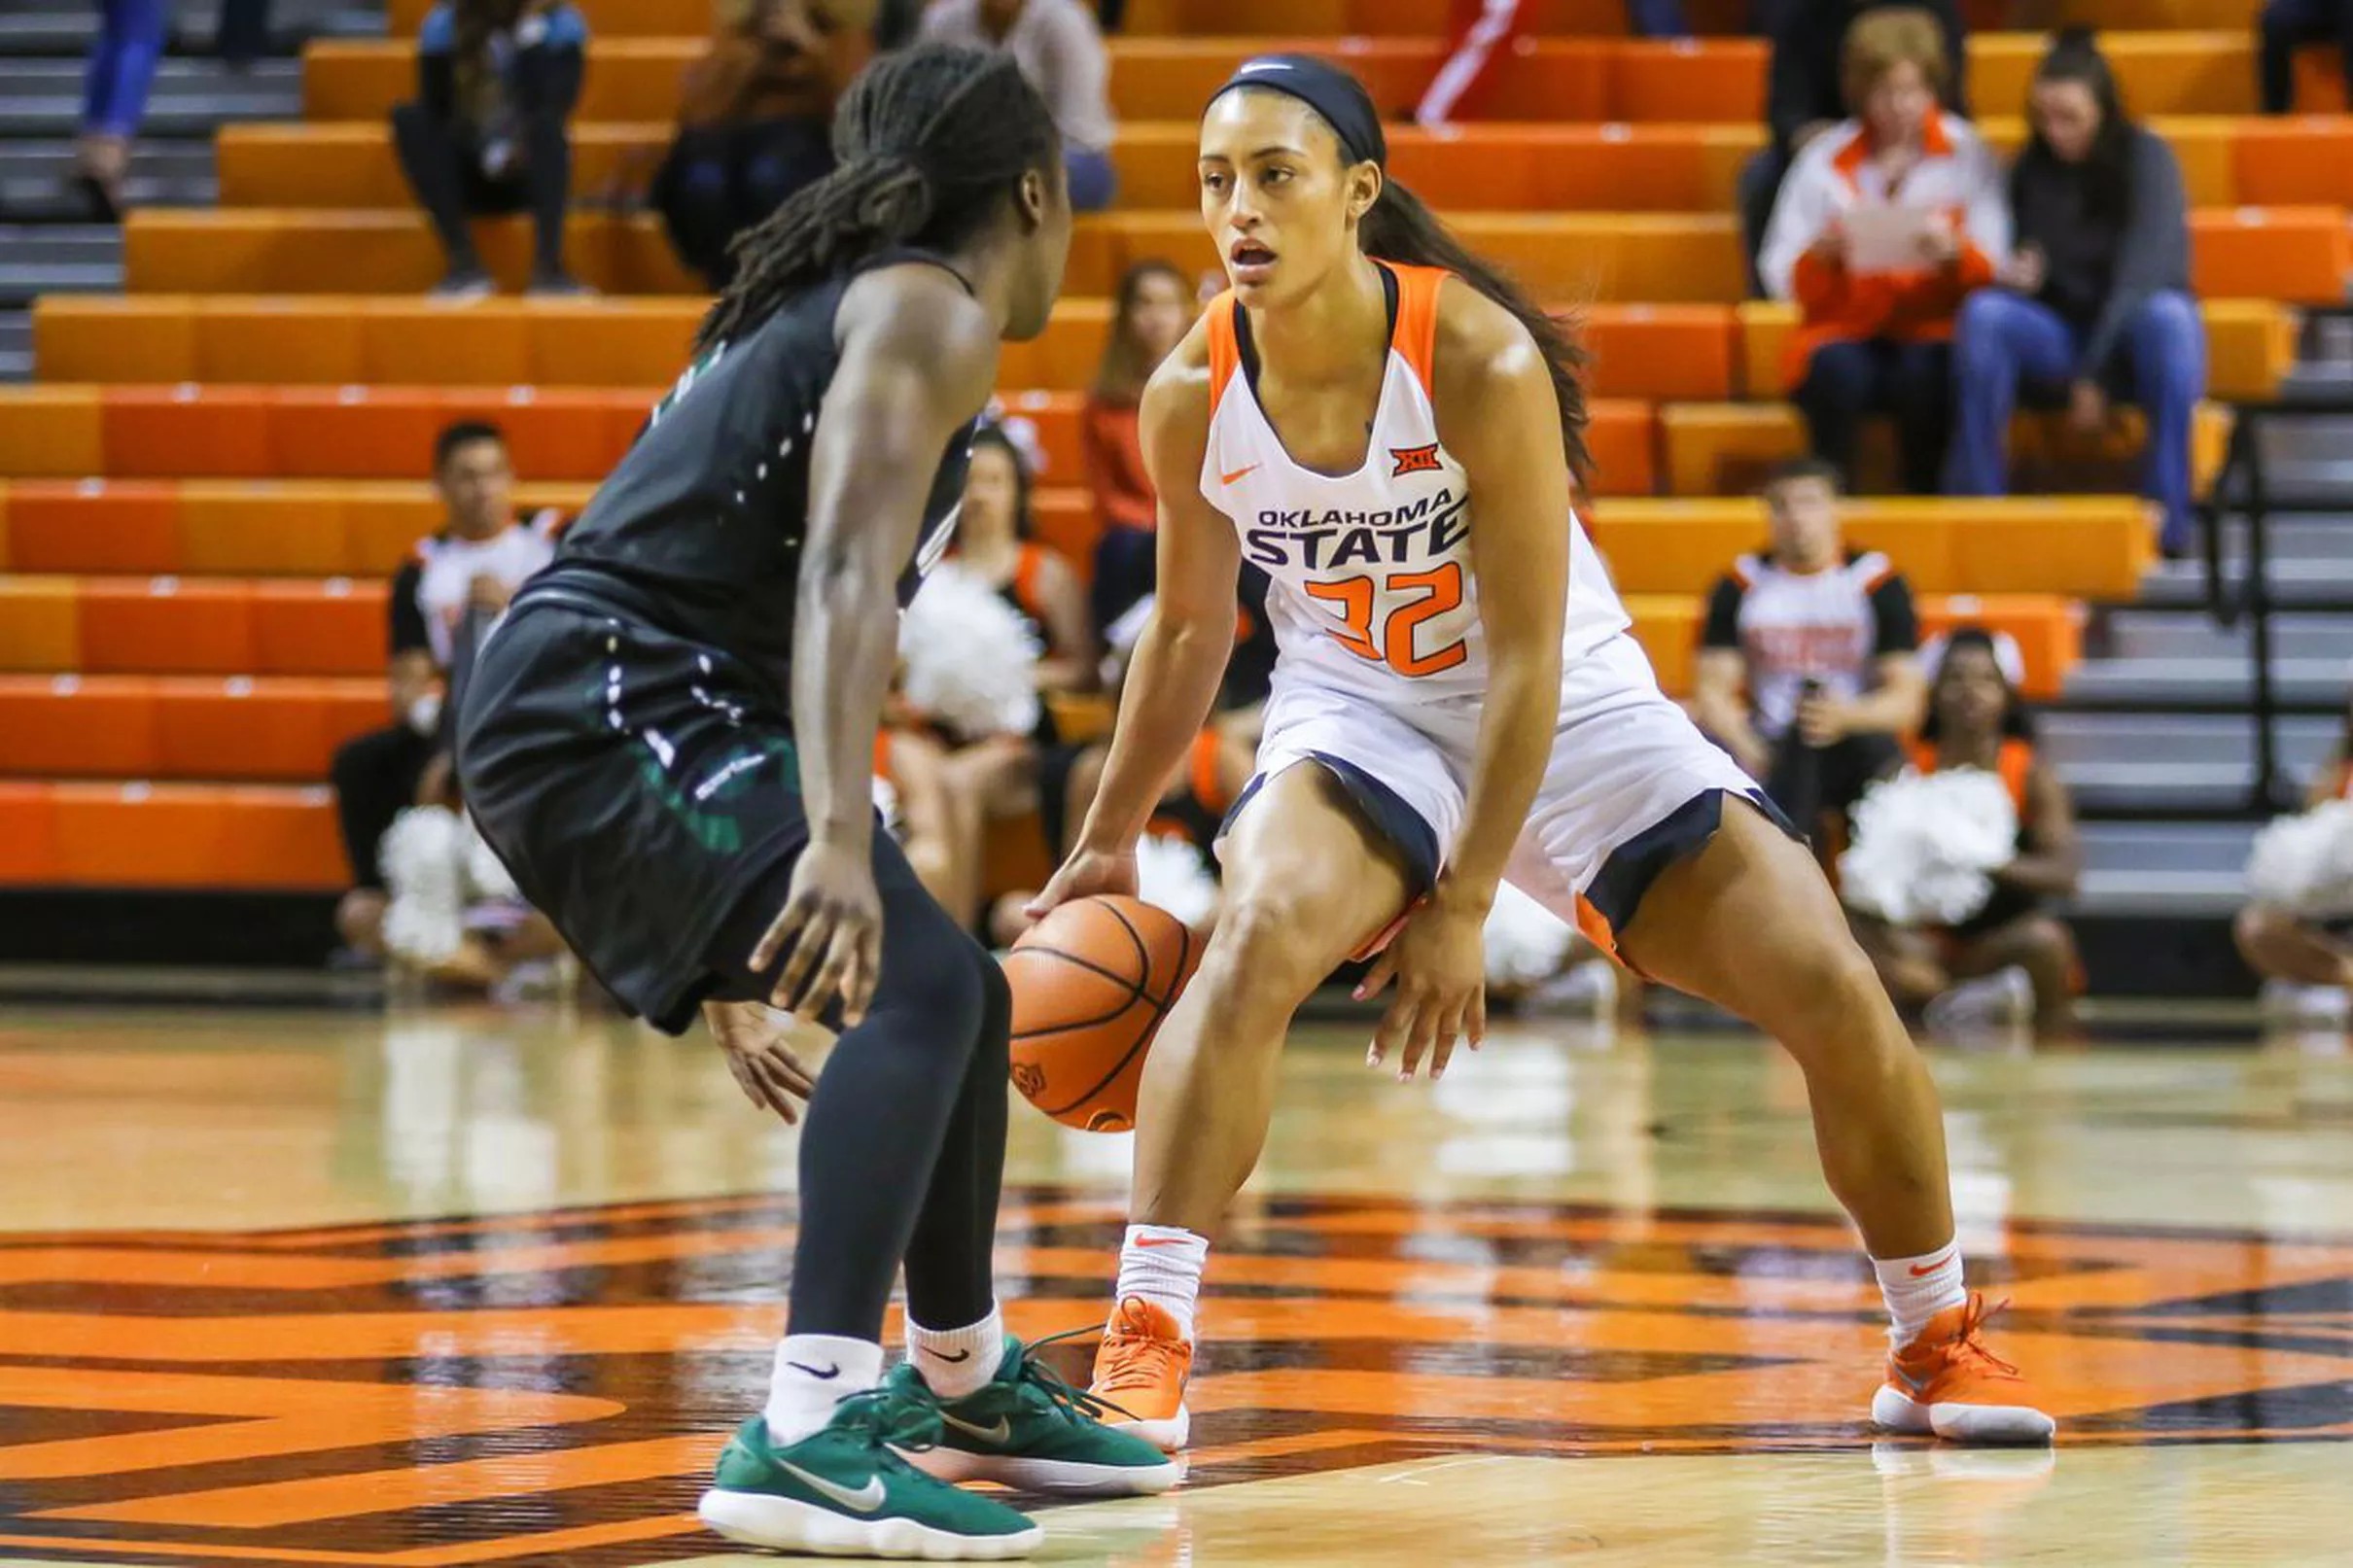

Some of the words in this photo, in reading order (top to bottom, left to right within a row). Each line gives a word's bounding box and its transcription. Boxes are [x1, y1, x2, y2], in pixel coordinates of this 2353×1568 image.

[1247, 495, 1469, 569] STATE
[1258, 488, 1453, 527] OKLAHOMA
[1303, 560, 1468, 679] 32
